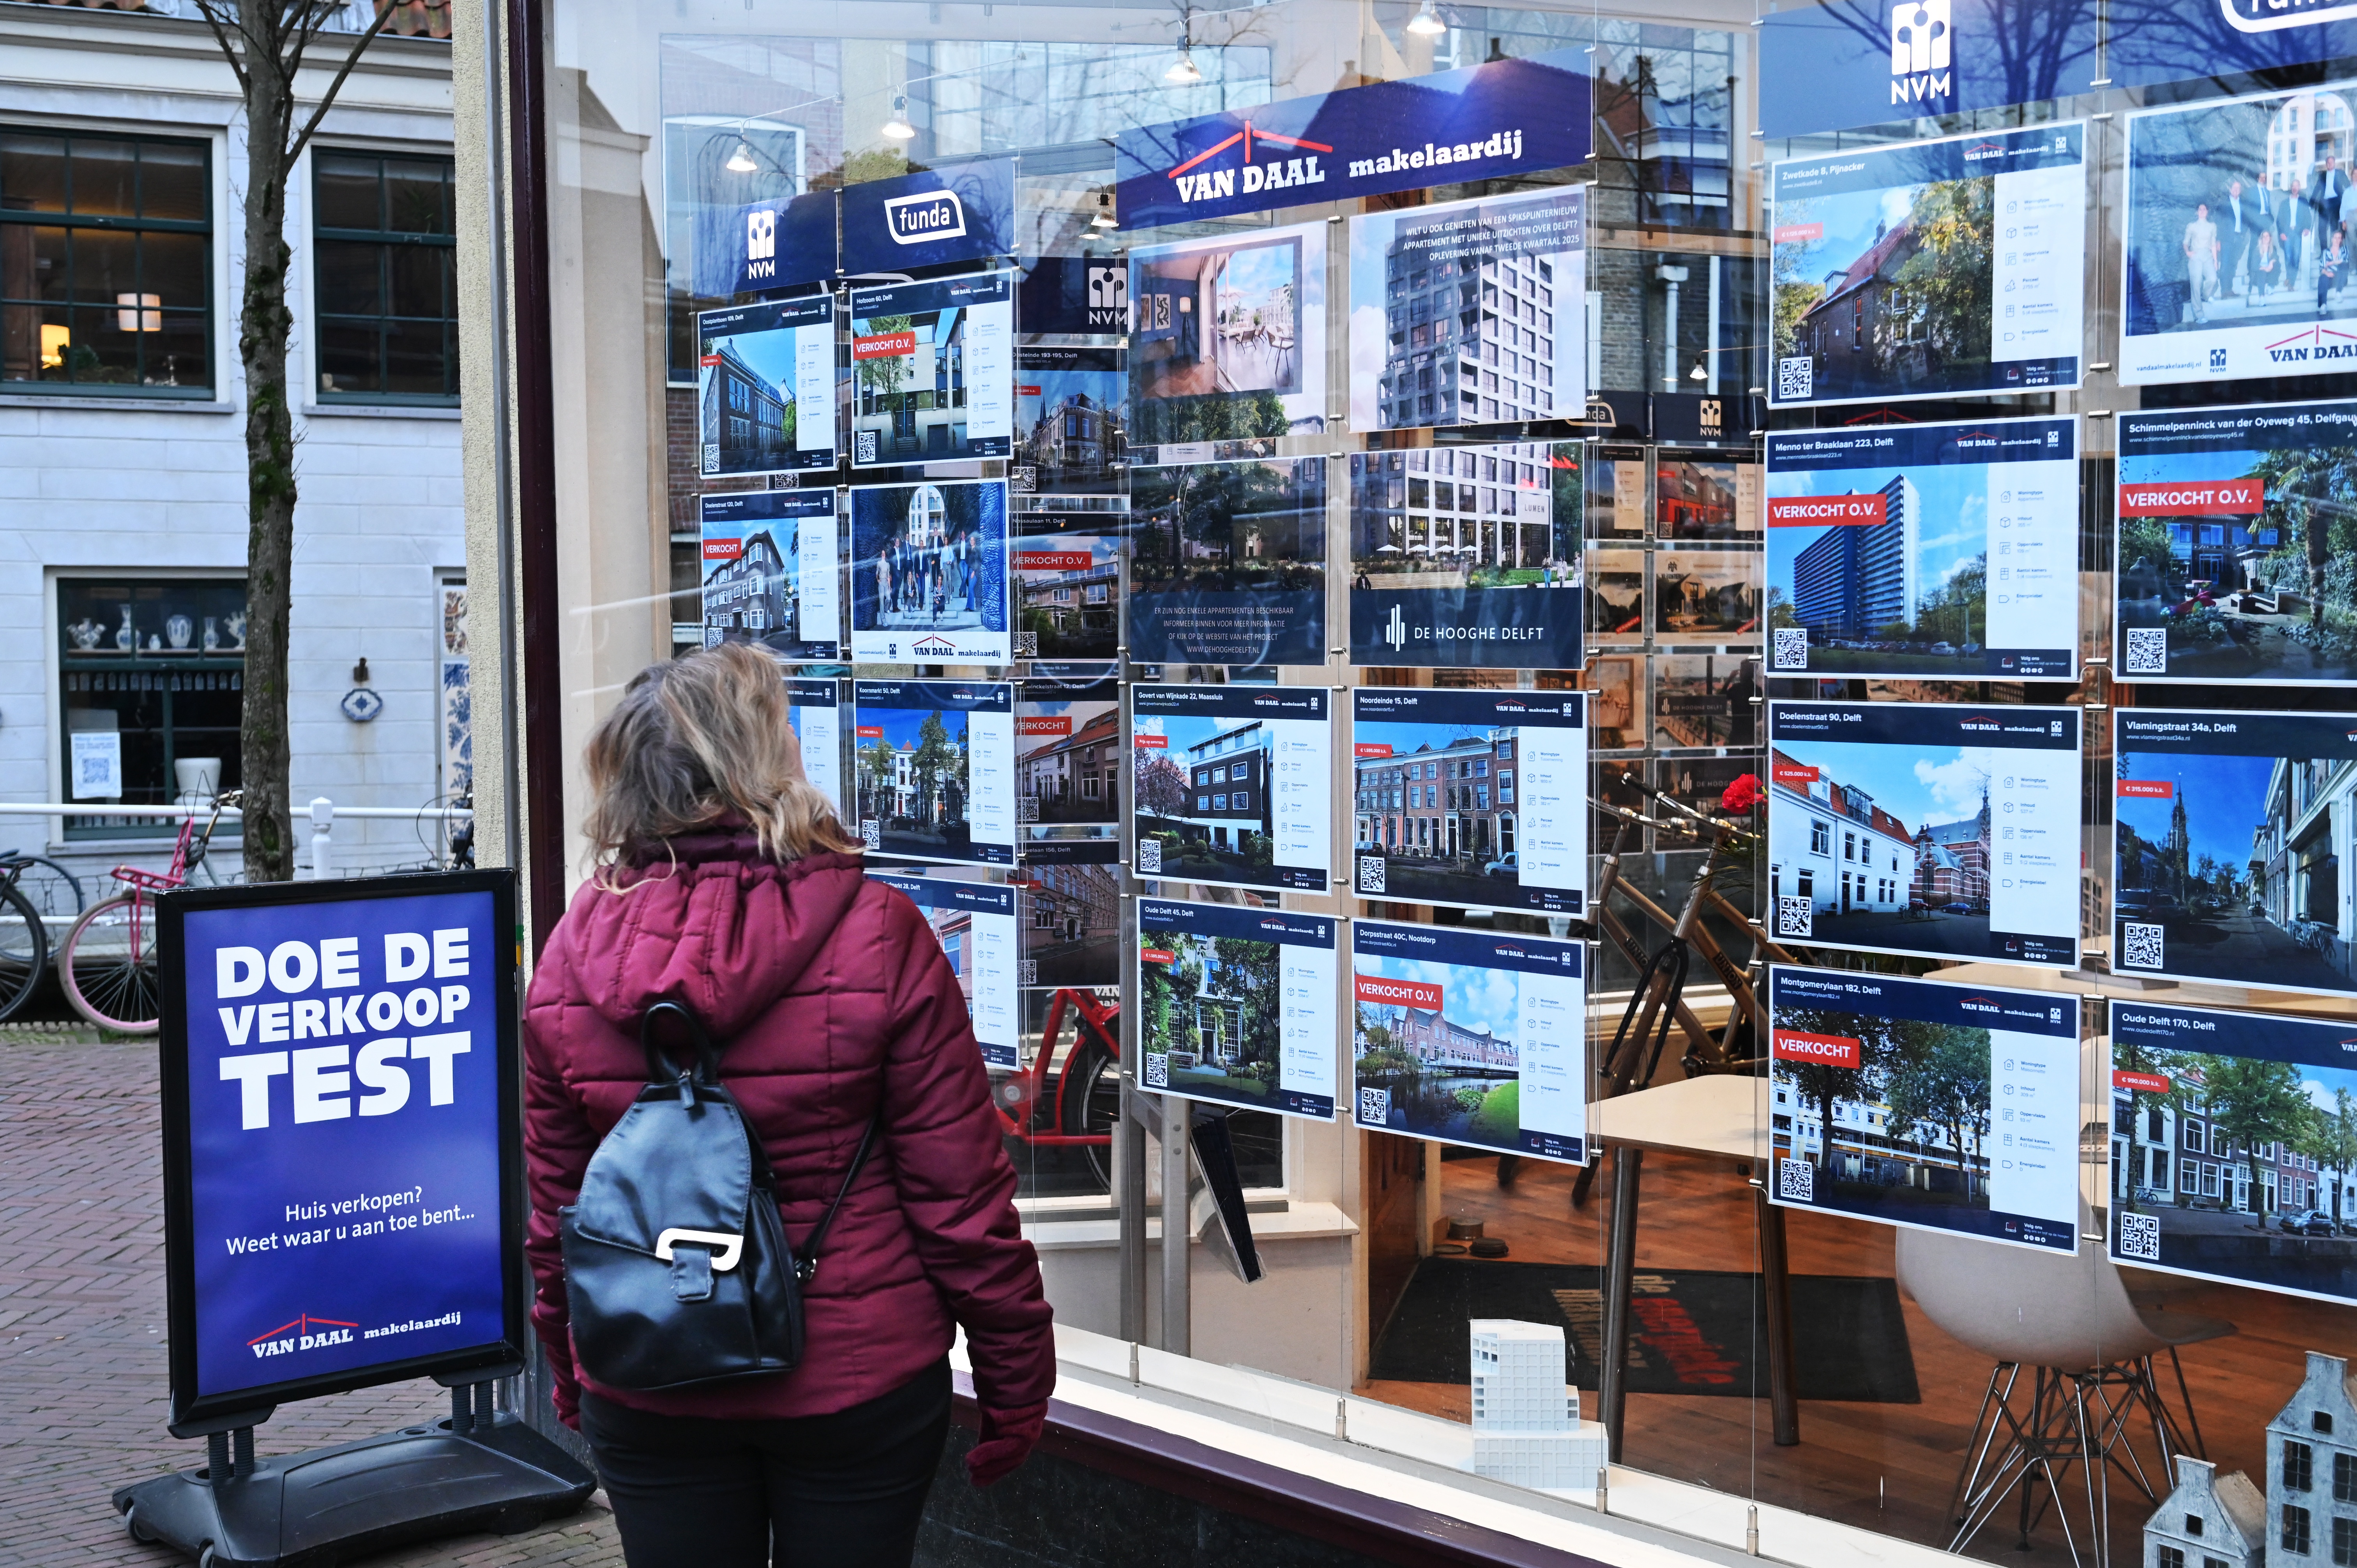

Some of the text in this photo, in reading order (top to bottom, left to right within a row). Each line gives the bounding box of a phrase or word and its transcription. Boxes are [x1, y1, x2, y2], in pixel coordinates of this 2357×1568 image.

[1892, 72, 1950, 104] NVM
[1176, 130, 1521, 203] VAN DAAL makelaardij
[1783, 168, 1819, 180] Zwetkade
[1830, 163, 1865, 175] Pijnacker
[899, 203, 949, 231] funda
[1406, 228, 1421, 236] WILT
[1429, 223, 1443, 233] OOK
[1445, 219, 1476, 231] GENIETEN
[1478, 217, 1492, 227] VAN
[1494, 215, 1506, 224] EEN
[1509, 206, 1577, 222] SPIKSPLINTERNIEUW
[1404, 220, 1578, 250] APPARTEMENT MET UNIEKE UITZICHTEN OVER DELFT?
[1429, 234, 1579, 261] OPLEVERING VANAF TWEEDE KWARTAAL 2025
[749, 260, 774, 279] NVM
[1089, 311, 1127, 325] NVM
[856, 339, 910, 352] VERKOCHT O.V.
[2270, 348, 2308, 362] VAN
[2137, 362, 2201, 371] vandaalmakelaardij.nl
[1700, 427, 1721, 436] NVM
[2129, 420, 2215, 433] Schimmelpenninck
[2237, 418, 2253, 427] der
[2255, 418, 2294, 427] Oyeweg
[2297, 415, 2312, 424] 45,
[1815, 441, 1853, 449] Braaklaan
[1875, 438, 1893, 446] Delft
[2127, 489, 2252, 506] VERKOCHT O.V.
[1774, 503, 1877, 518] VERKOCHT O.V.
[705, 544, 737, 553] VERKOCHT
[1415, 627, 1543, 639] DE HOOGHE DELFT
[958, 650, 1000, 658] makelaardij
[1780, 712, 1827, 720] Doelenstraat
[1829, 713, 1841, 722] 90,
[2127, 721, 2236, 732] Vlamingstraat 34a, Delft
[1360, 929, 1392, 939] Dorpsstraat
[1409, 934, 1435, 945] Nootdorp
[216, 928, 469, 999] DOE DE
[1359, 983, 1436, 1002] VERKOCHT O.V.
[1781, 977, 1881, 995] Montgomerylaan 182, Delft
[217, 985, 471, 1046] VERKOOP
[2122, 1014, 2215, 1030] Oude Delft 170, Delft
[2122, 1027, 2174, 1036] www.oudedelft170.nl
[1779, 1038, 1850, 1058] VERKOCHT
[219, 1031, 471, 1130] TEST
[286, 1186, 422, 1222] Huis verkopen?
[226, 1205, 474, 1255] Weet waar u aan toe bent...
[253, 1312, 460, 1358] VAN DAAL makelaardij
